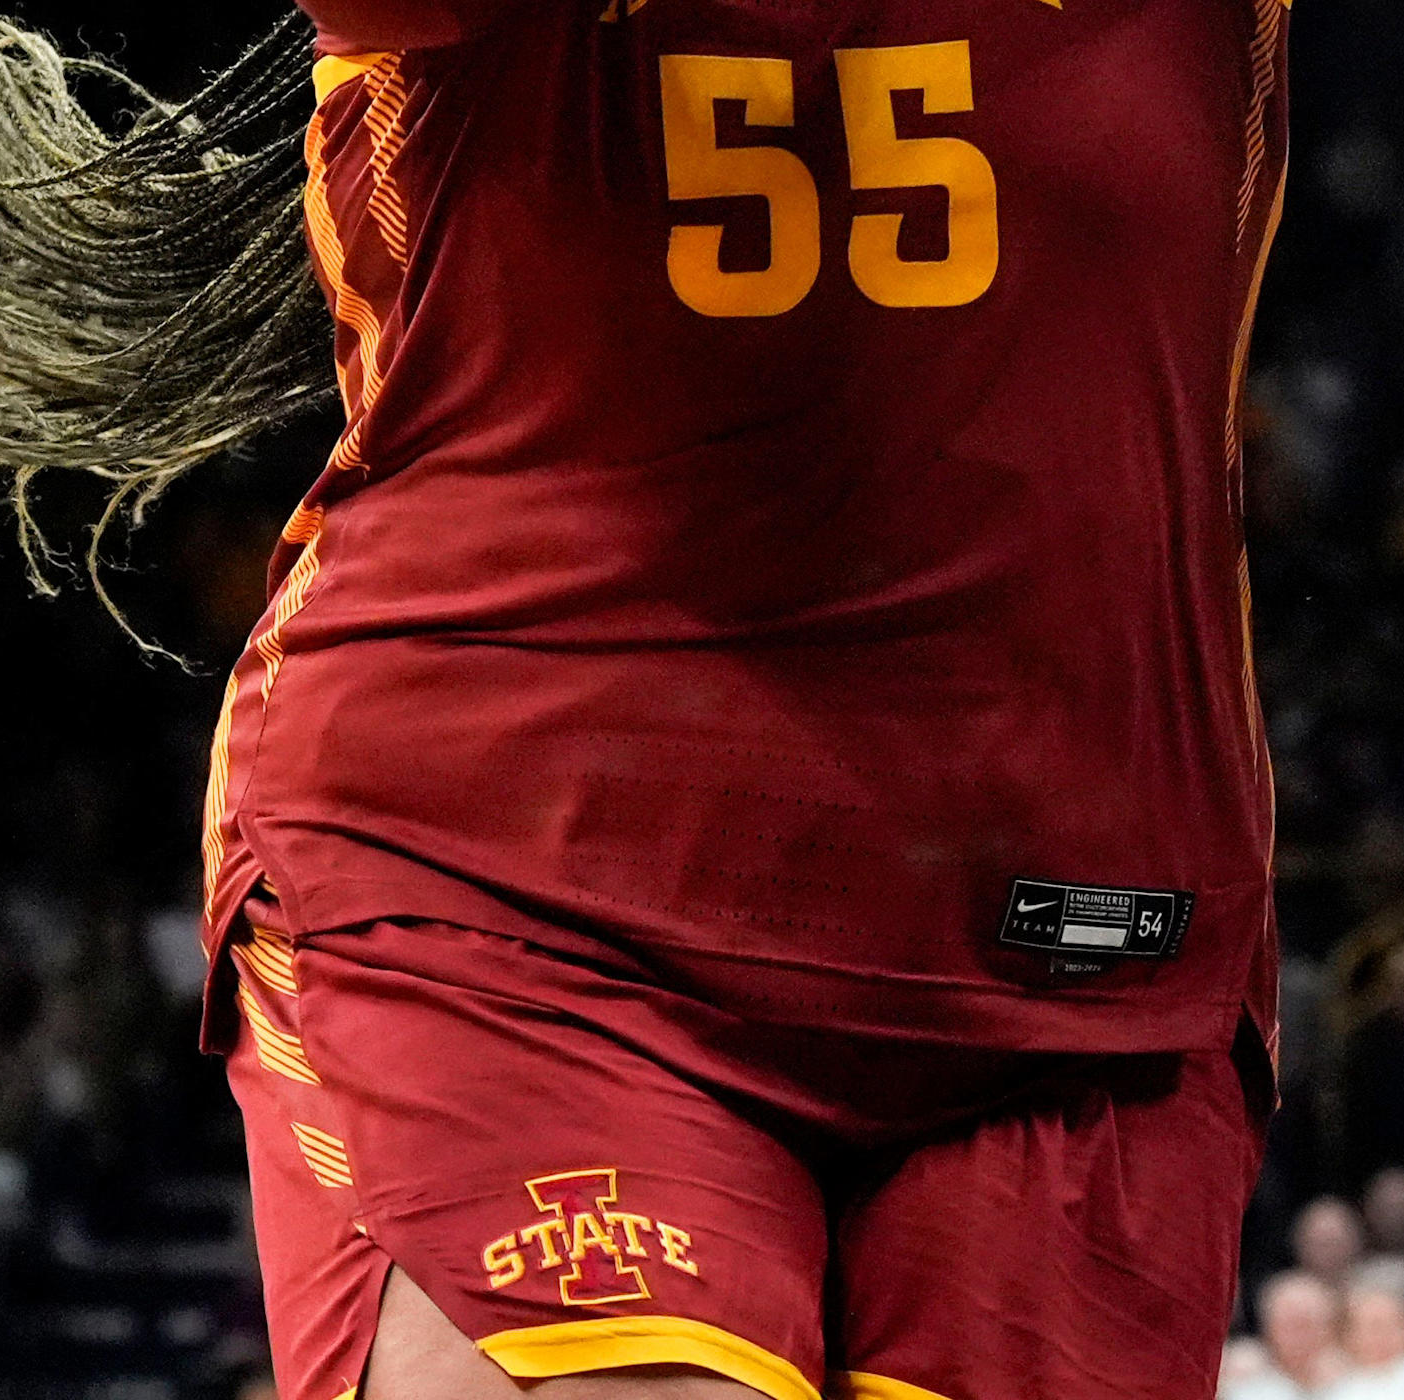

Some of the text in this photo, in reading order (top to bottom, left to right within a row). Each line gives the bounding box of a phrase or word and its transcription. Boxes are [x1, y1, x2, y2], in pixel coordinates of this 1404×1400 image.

[659, 39, 999, 318] 55
[1069, 892, 1131, 907] ENGINEERED
[1011, 919, 1056, 934] TEAM
[1137, 910, 1163, 938] 54
[483, 1212, 699, 1289] STATE
